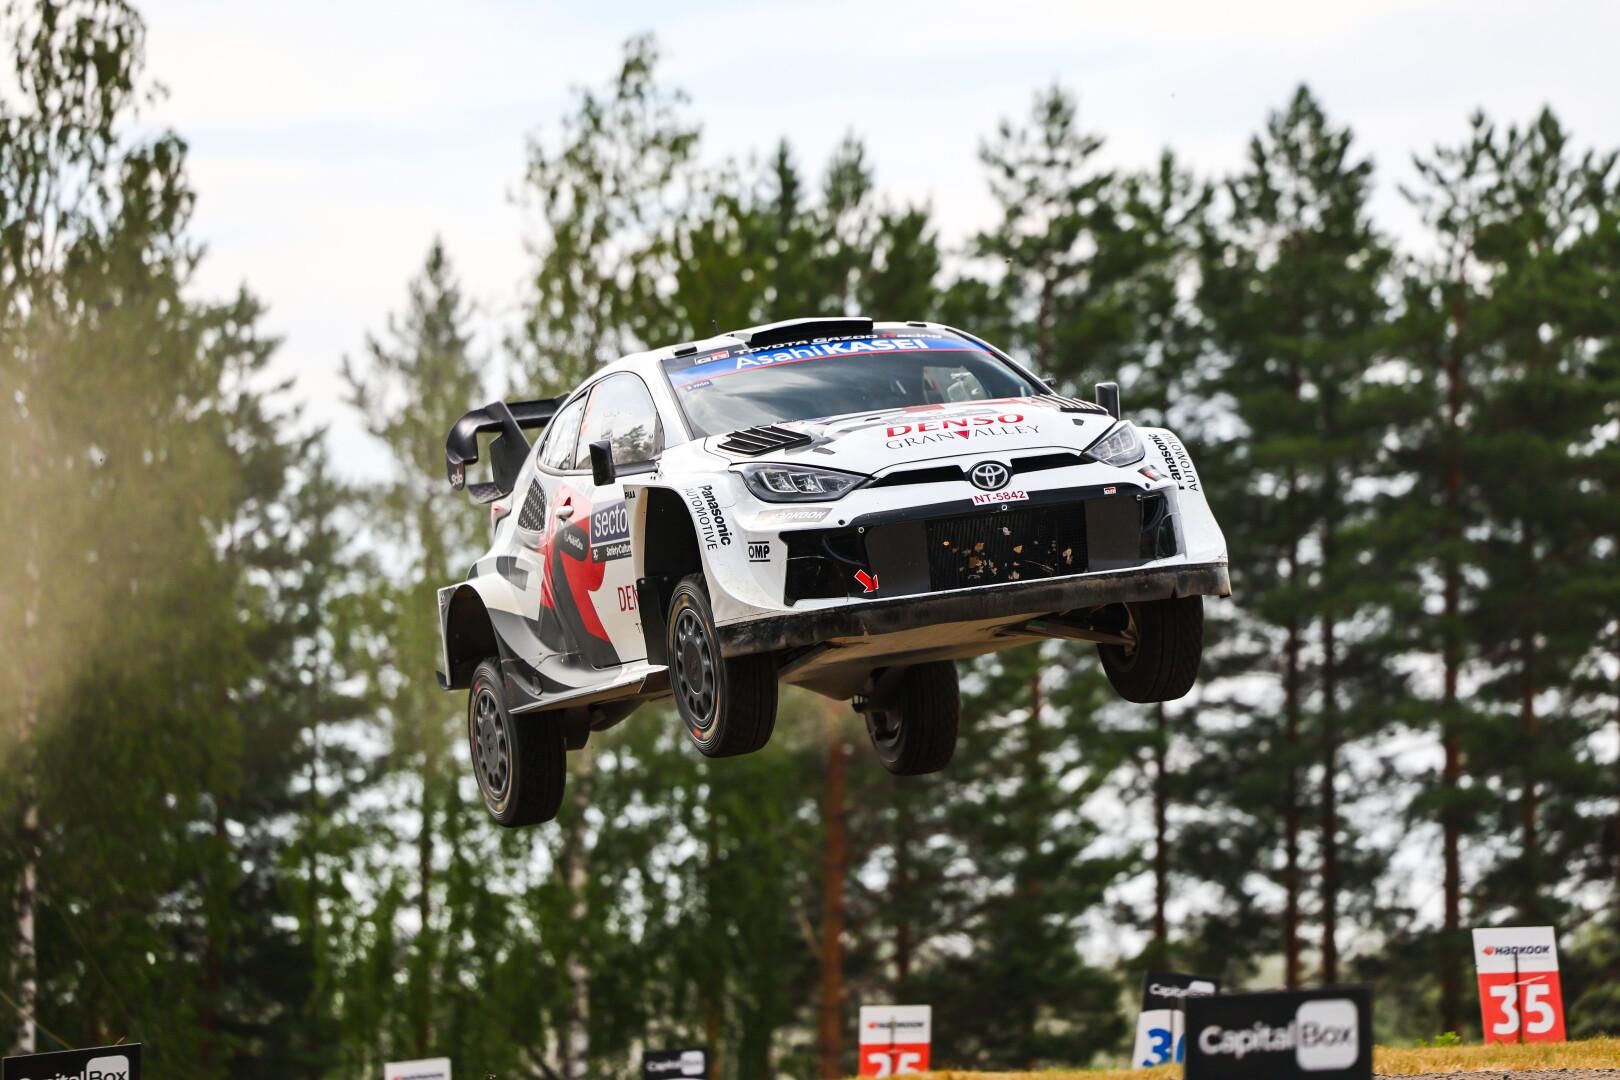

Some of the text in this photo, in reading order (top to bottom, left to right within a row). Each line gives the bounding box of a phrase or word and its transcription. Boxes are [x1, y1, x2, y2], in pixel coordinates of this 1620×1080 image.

[734, 340, 808, 355] TOYOTA
[811, 334, 878, 344] GAZOO
[887, 413, 1024, 438] DENSO
[974, 490, 1026, 504] NT-5842
[595, 505, 627, 537] secto
[683, 488, 718, 551] AUTOMOTIVE
[698, 485, 733, 546] Panasonic
[748, 544, 770, 559] OMP
[618, 585, 639, 612] DEN
[1490, 984, 1555, 1035] 35
